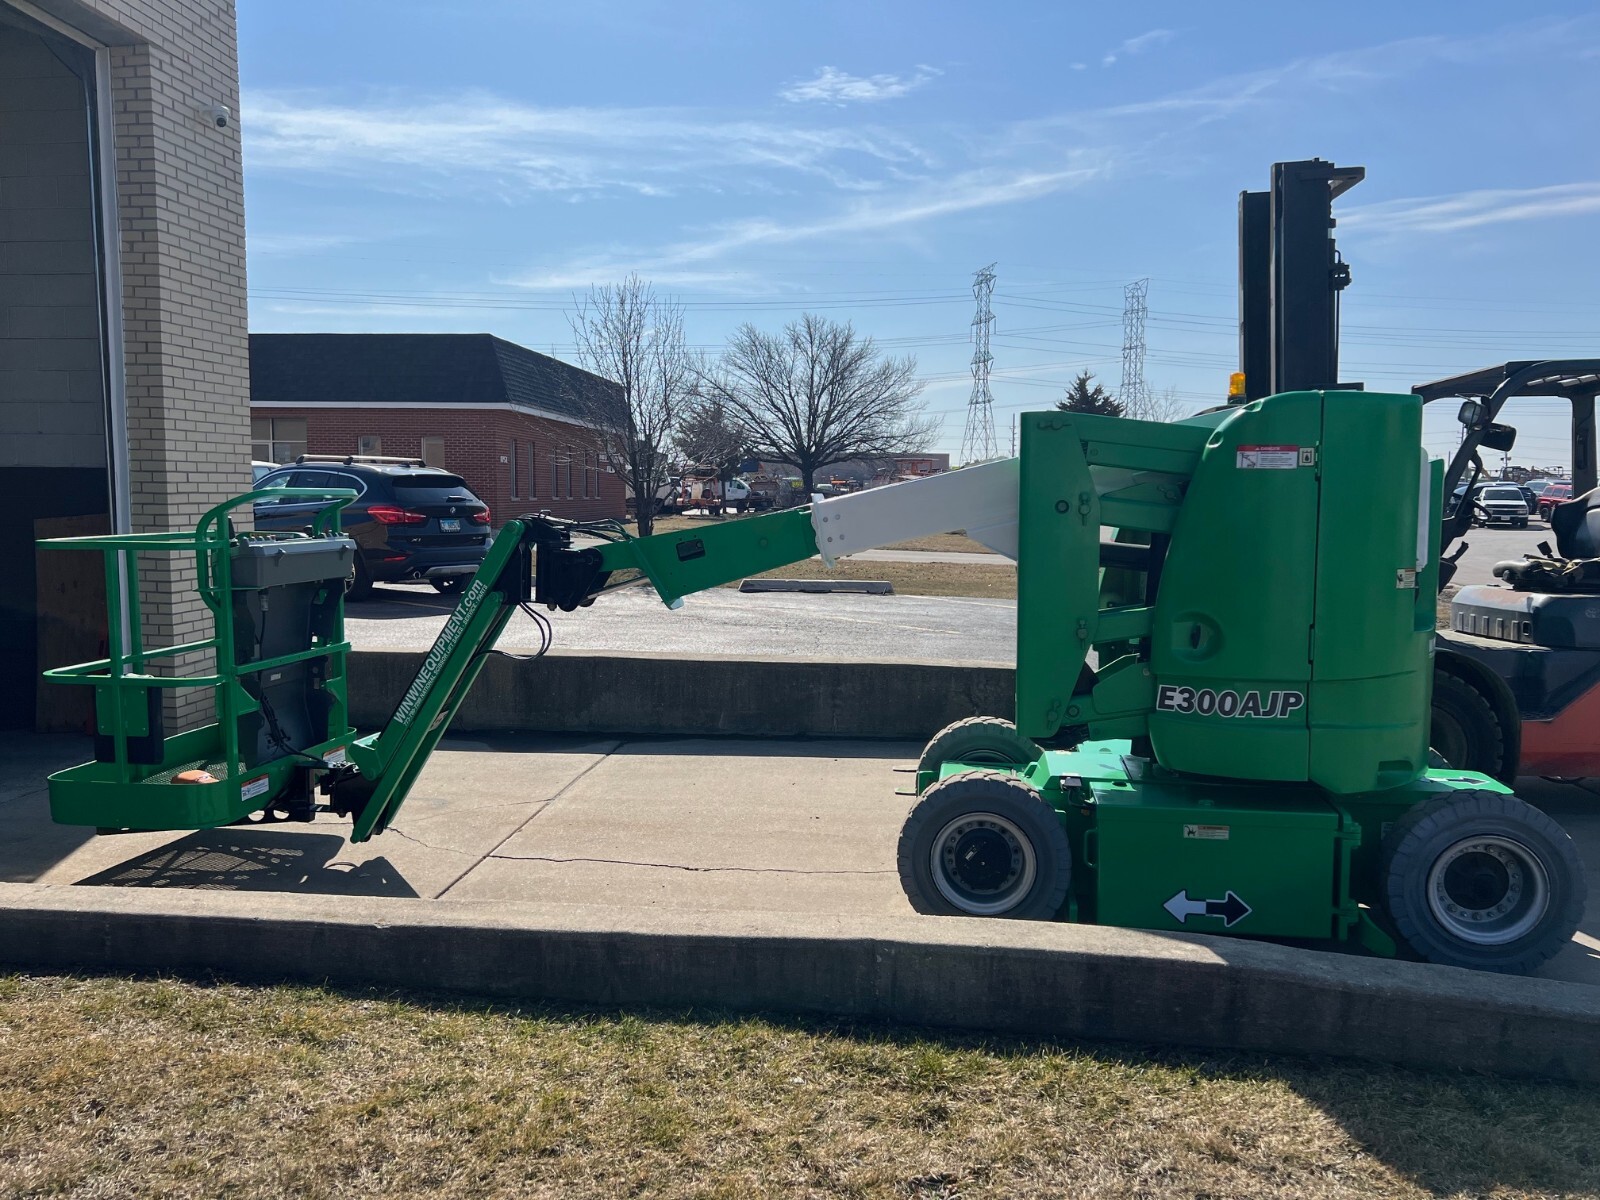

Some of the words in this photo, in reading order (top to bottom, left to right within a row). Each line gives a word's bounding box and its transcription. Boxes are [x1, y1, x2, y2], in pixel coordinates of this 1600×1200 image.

[393, 579, 483, 724] WINWINEQUIPMENT.com
[420, 674, 437, 699] NATIONAL
[434, 653, 449, 675] SCISSOR
[445, 642, 454, 655] LIFT
[452, 626, 463, 644] SALES
[463, 603, 478, 625] SERVICE
[476, 584, 488, 602] PARTS
[1156, 684, 1305, 719] E300AJP
